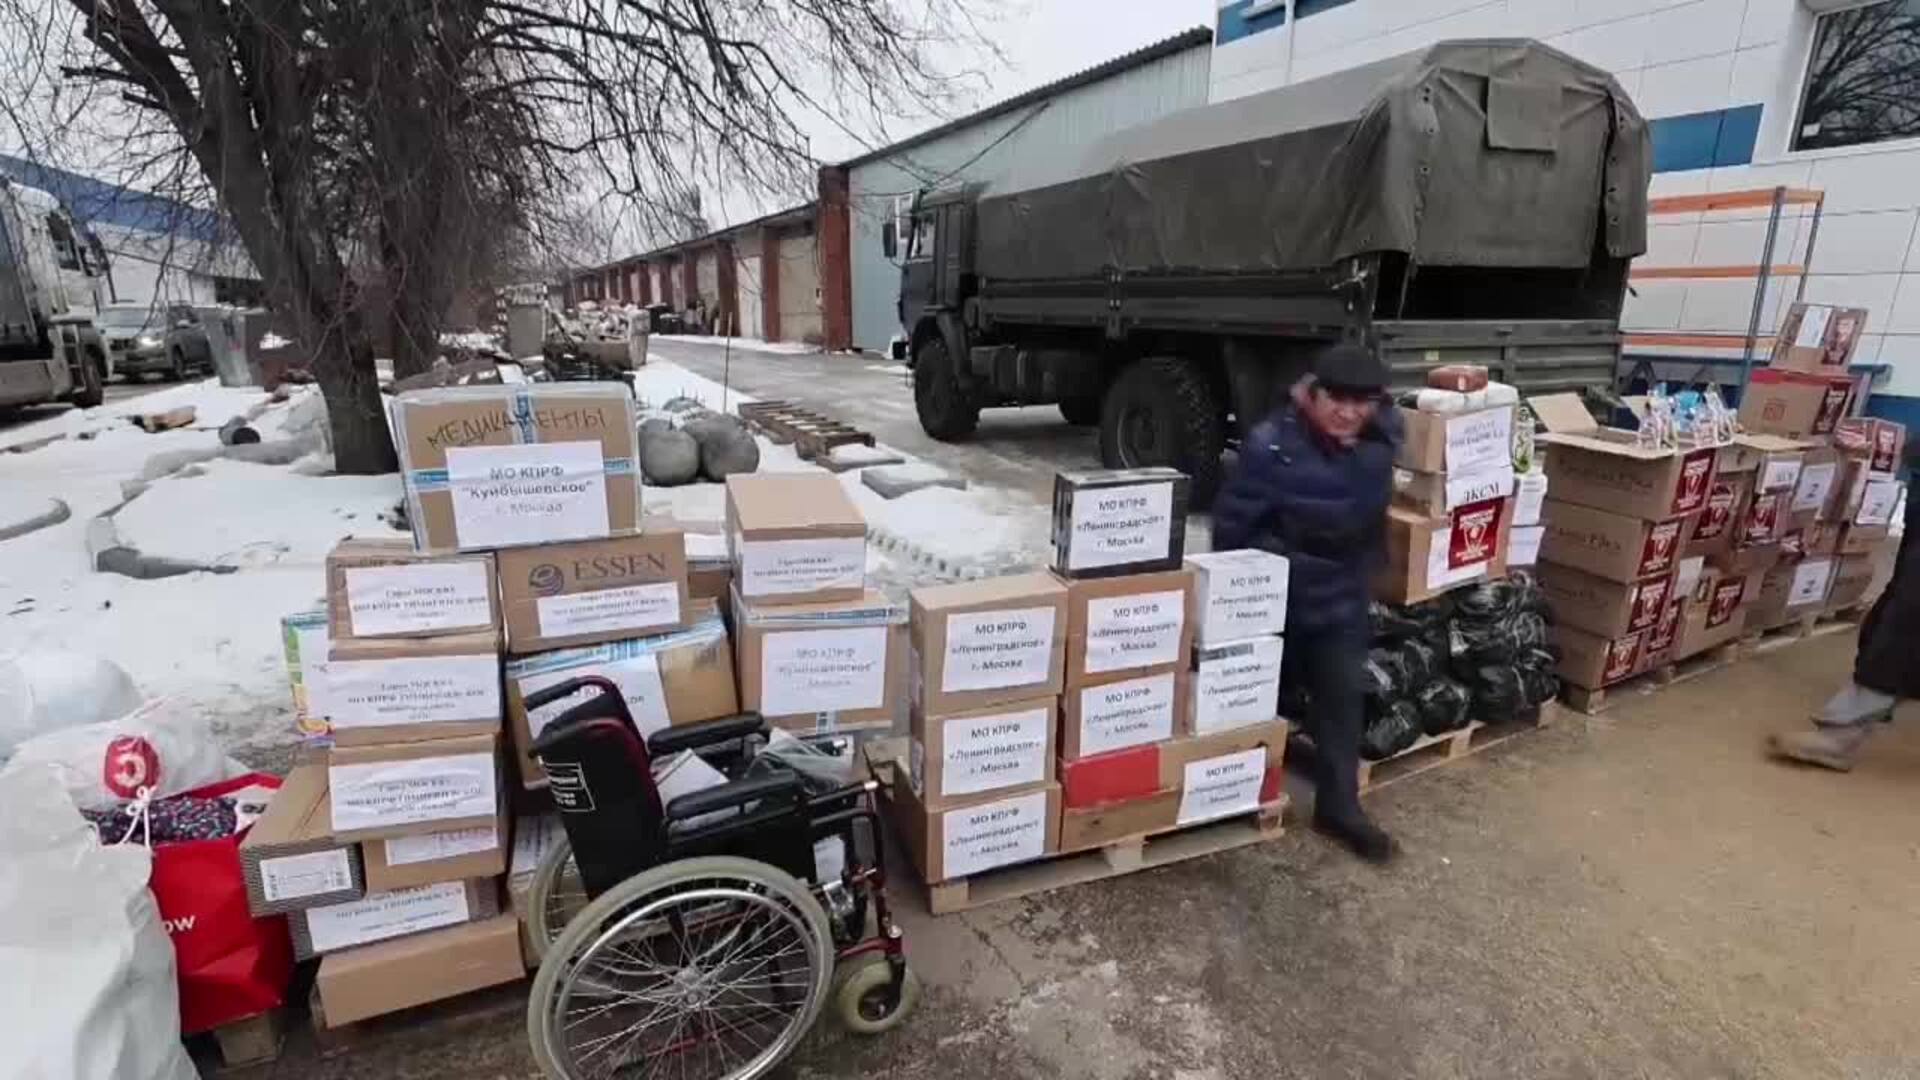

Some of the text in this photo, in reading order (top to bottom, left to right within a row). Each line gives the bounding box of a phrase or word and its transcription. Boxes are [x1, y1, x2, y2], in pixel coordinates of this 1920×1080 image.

[490, 465, 564, 481] МО КПРФ
[1098, 500, 1117, 511] МО
[573, 552, 667, 580] ESSEN
[1113, 608, 1131, 618] МО
[975, 624, 995, 635] МО
[1105, 693, 1122, 704] МО
[971, 728, 990, 739] МО
[970, 815, 989, 825] МО
